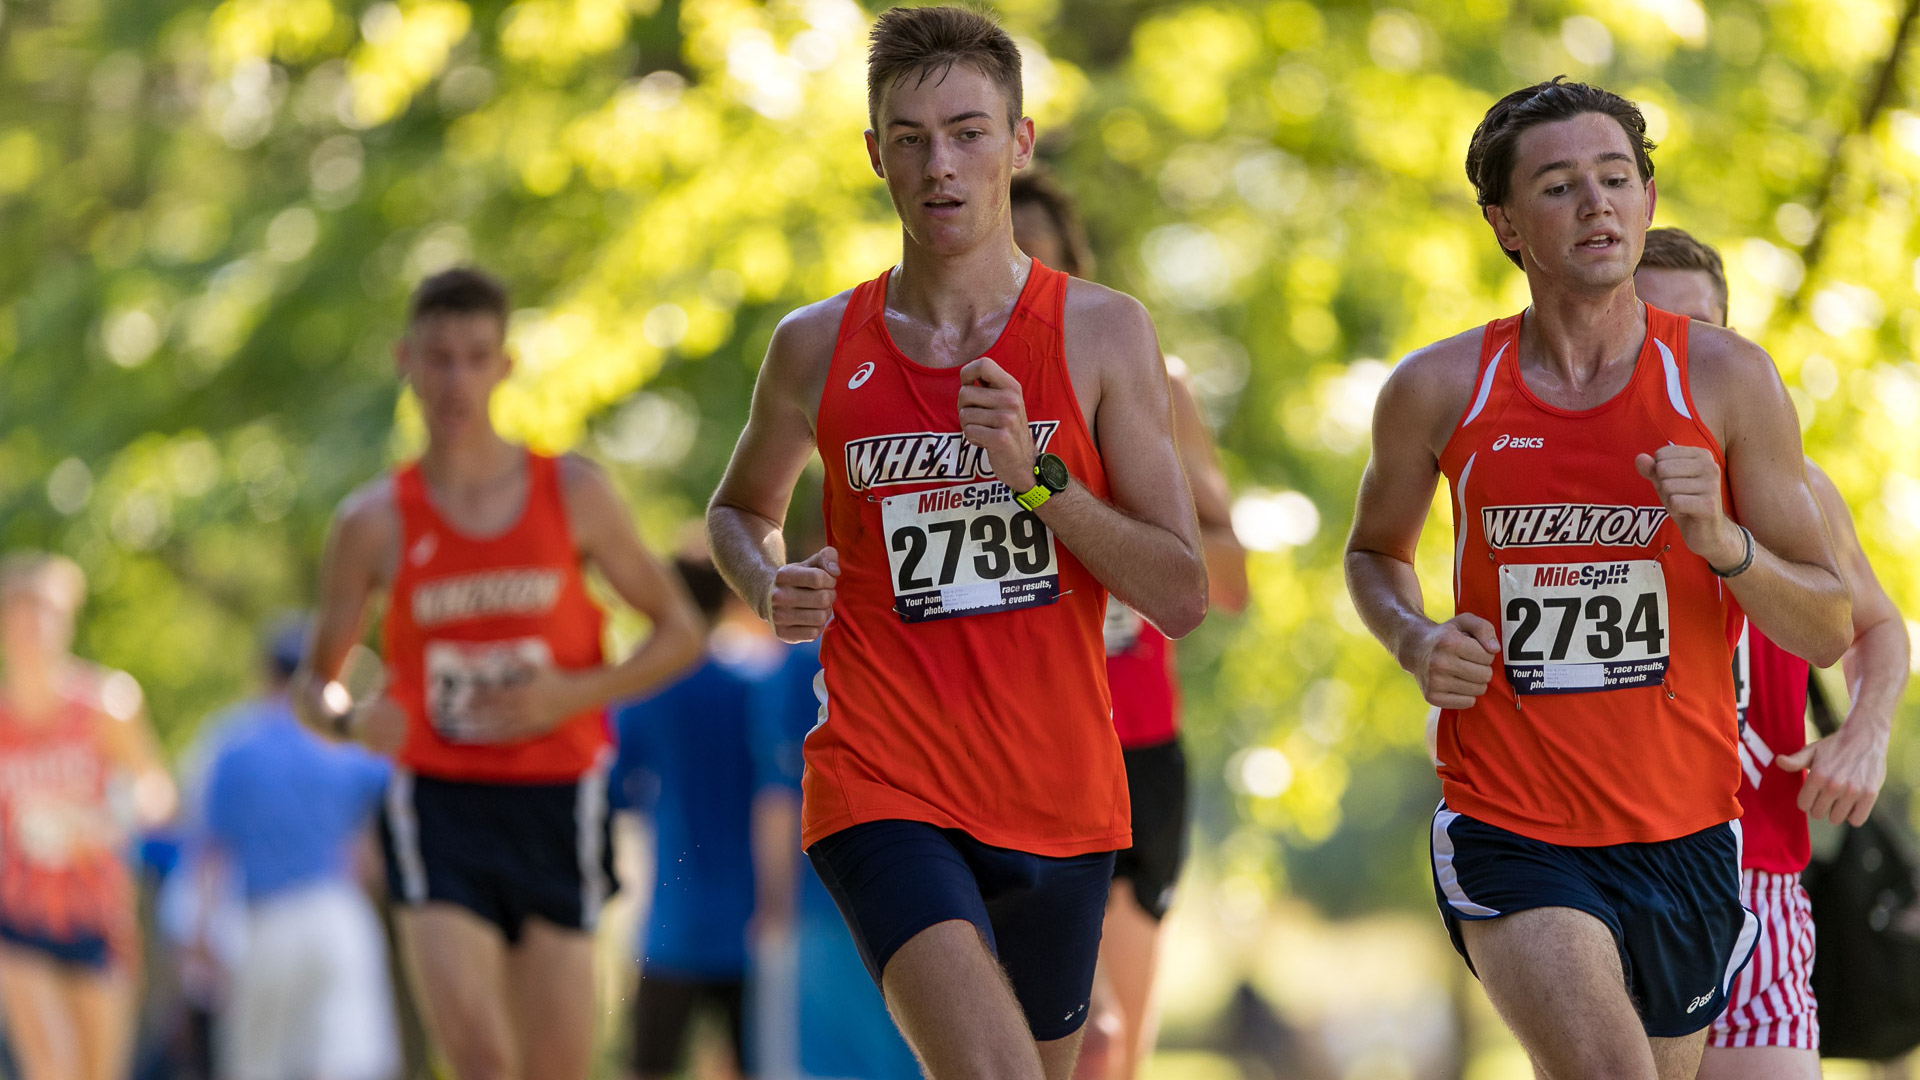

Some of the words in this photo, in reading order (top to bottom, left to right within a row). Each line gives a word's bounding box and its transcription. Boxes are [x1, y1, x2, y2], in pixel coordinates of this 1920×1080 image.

[1509, 437, 1544, 449] asics
[918, 482, 1011, 514] MileSplit
[1481, 503, 1670, 549] WHEATON
[891, 511, 1050, 591] 2739
[1533, 563, 1630, 589] MileSplit
[904, 597, 923, 608] Your
[1001, 584, 1020, 594] race
[1022, 580, 1052, 591] results,
[1008, 593, 1036, 604] events
[1506, 592, 1665, 661] 2734
[1512, 669, 1531, 678] Your
[1613, 666, 1633, 674] race
[1634, 661, 1665, 672] results,
[1619, 673, 1647, 684] events
